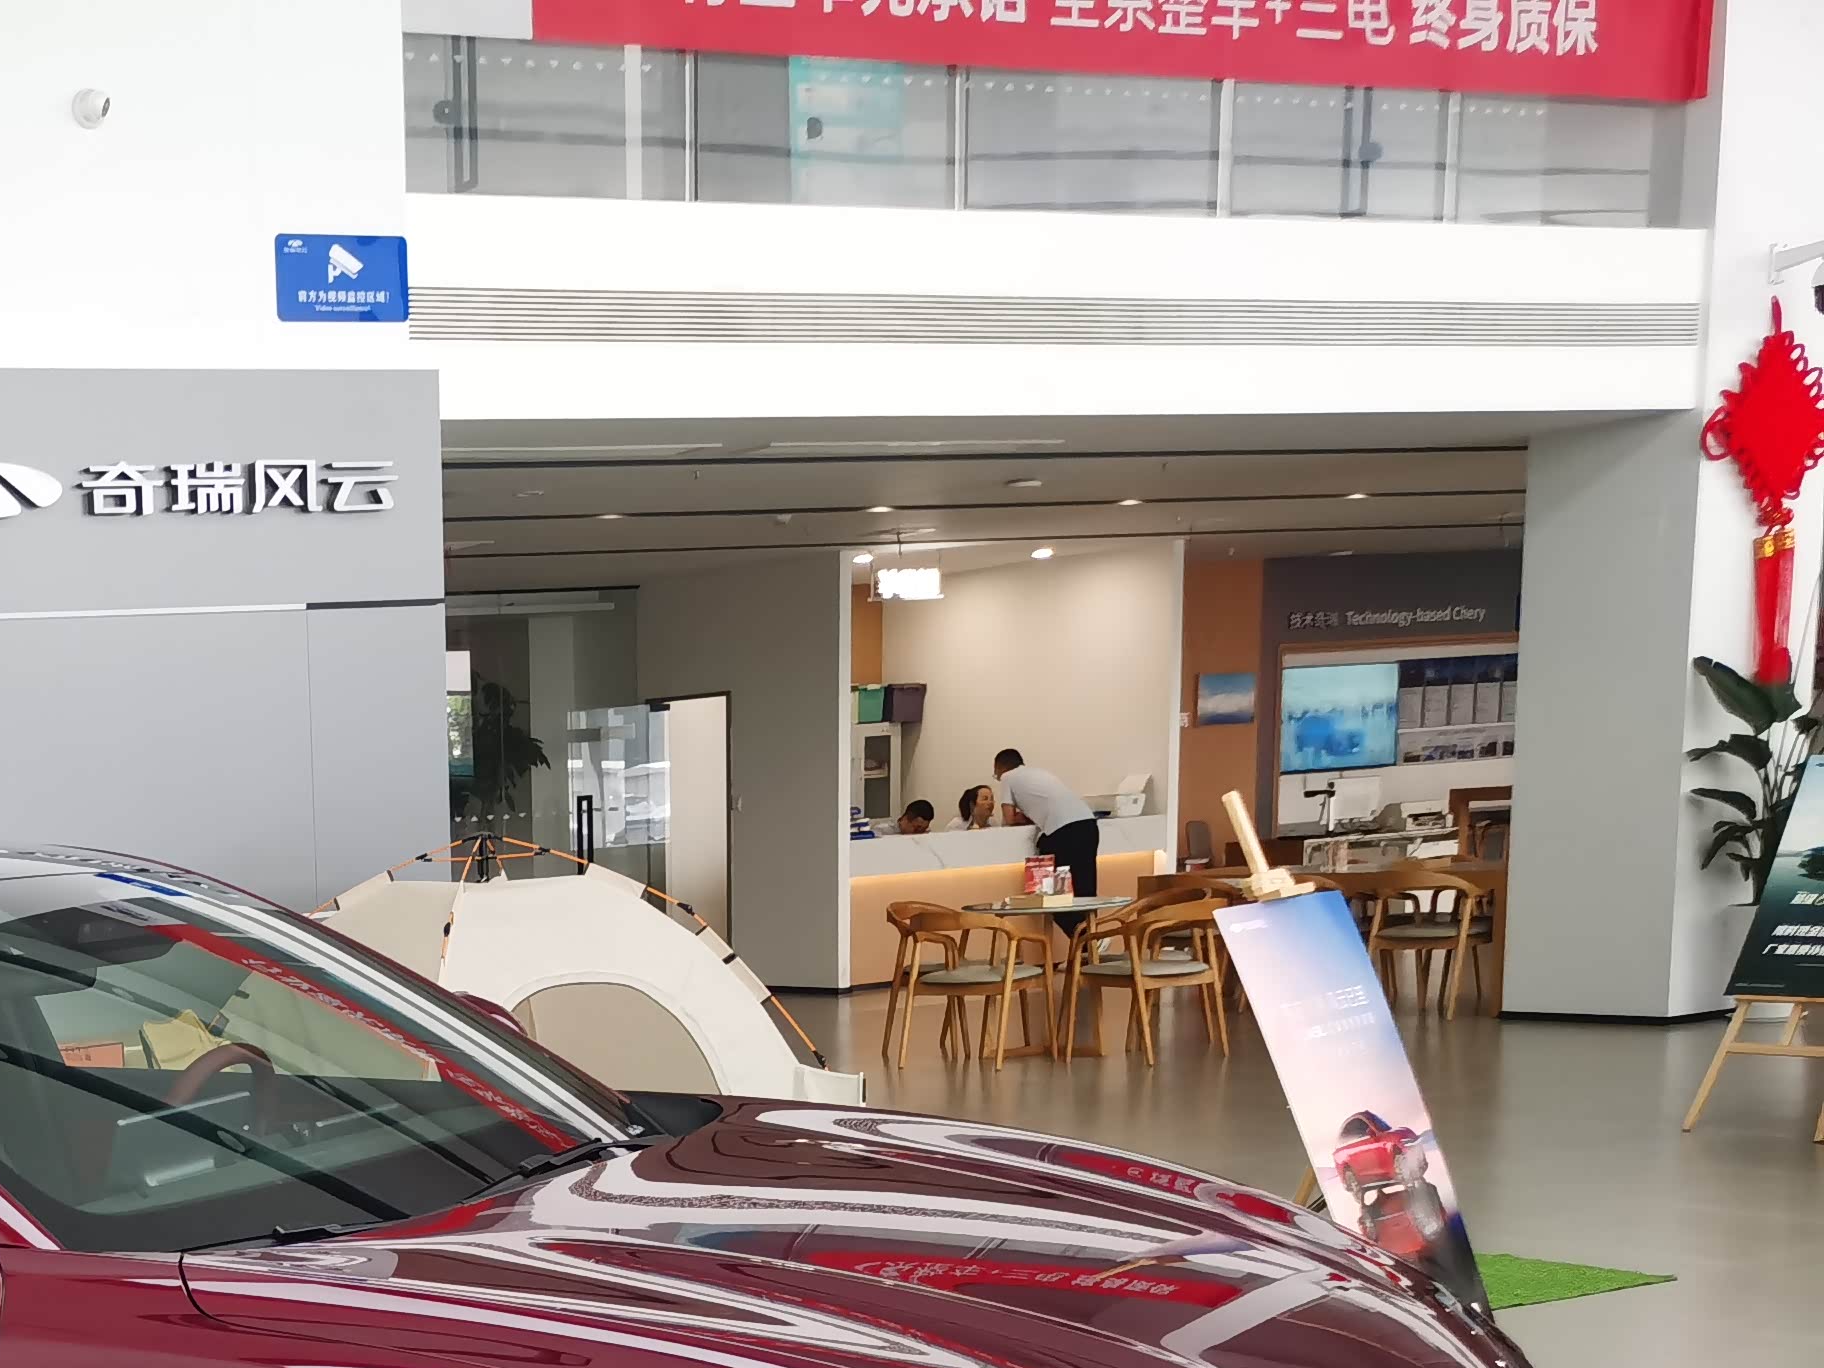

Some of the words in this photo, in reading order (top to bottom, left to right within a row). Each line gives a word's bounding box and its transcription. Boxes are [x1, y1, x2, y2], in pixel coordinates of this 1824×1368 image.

[1408, 0, 1599, 56] 终身质保
[81, 460, 399, 516] 奇瑞风云
[1345, 606, 1451, 628] Technology-based
[1452, 605, 1486, 623] Chery
